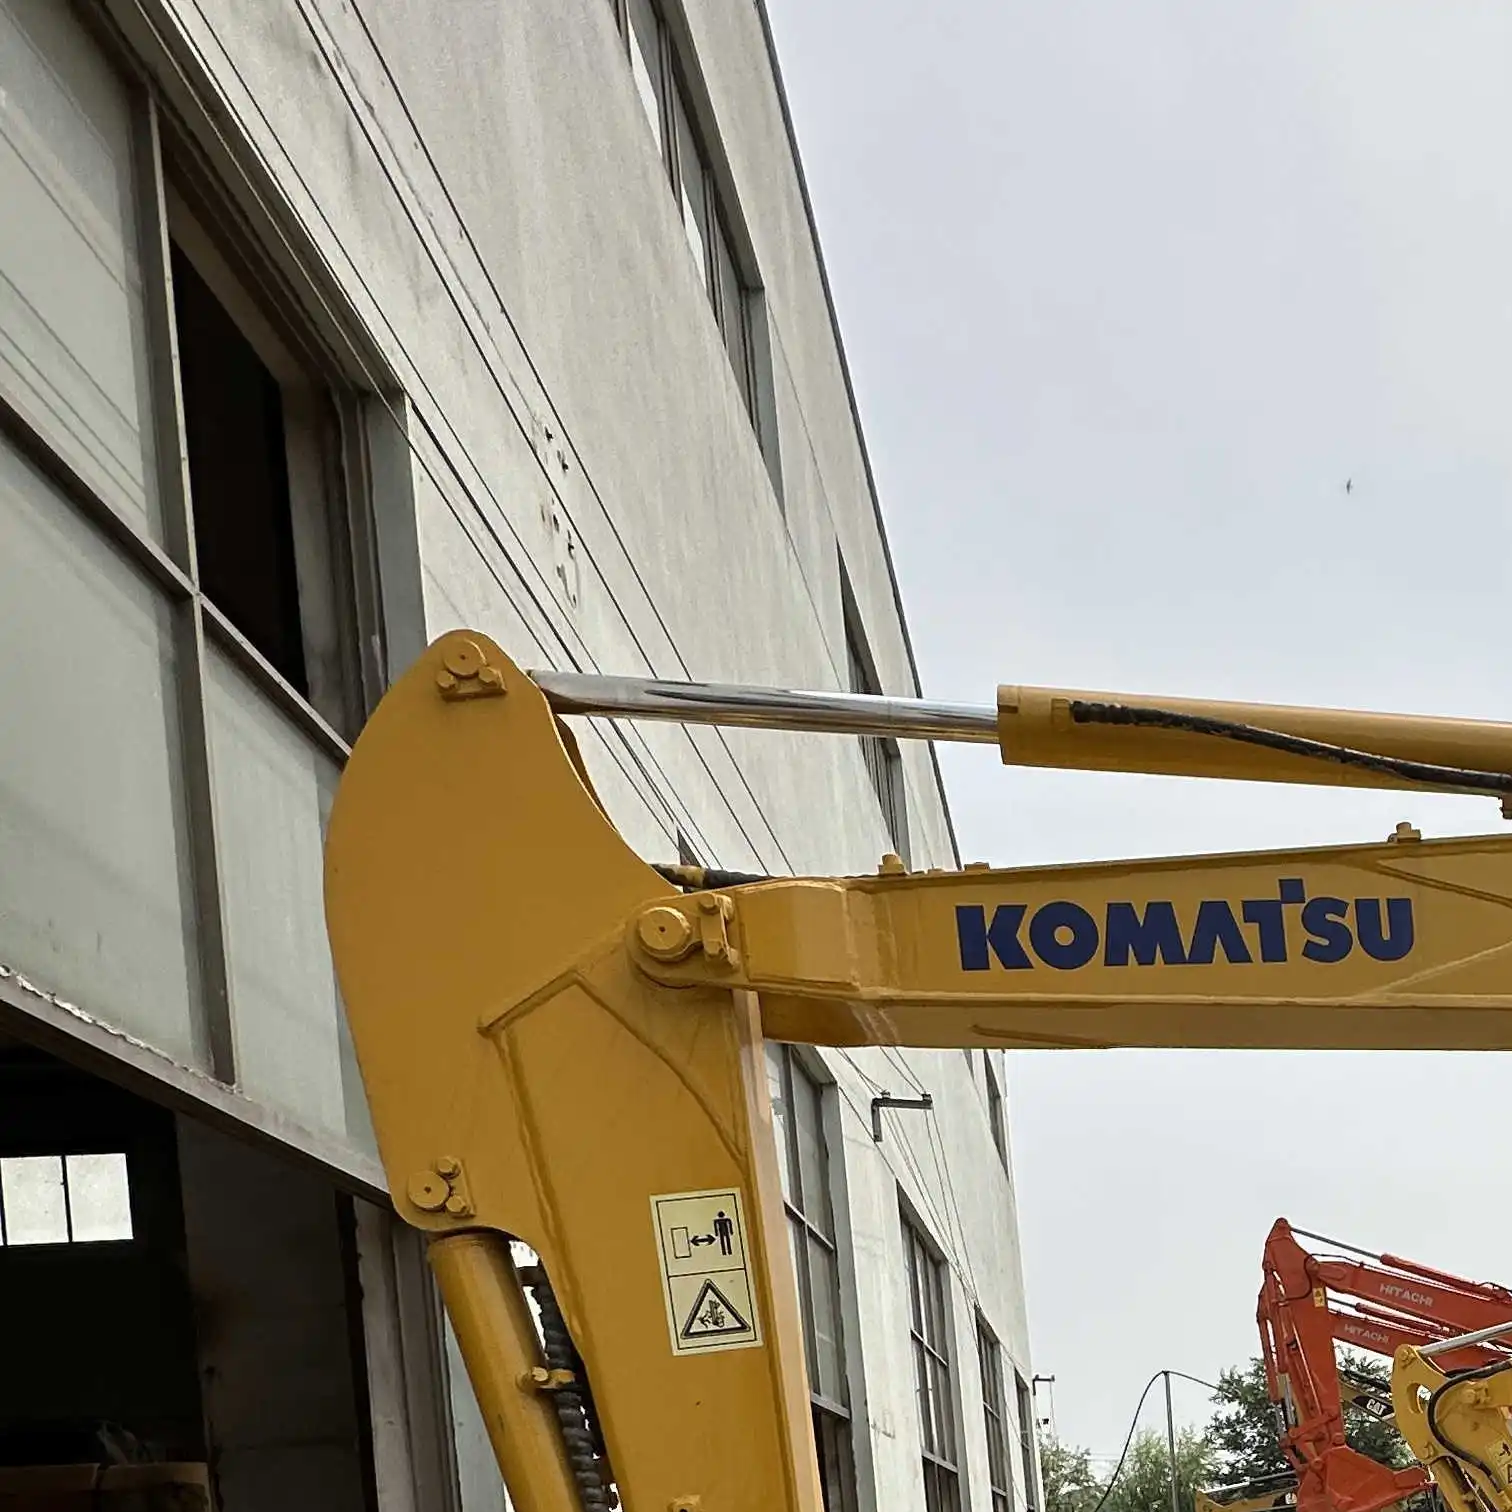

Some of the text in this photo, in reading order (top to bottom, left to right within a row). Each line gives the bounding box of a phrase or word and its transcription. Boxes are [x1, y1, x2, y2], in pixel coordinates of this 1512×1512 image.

[955, 878, 1414, 971] KOMATSU
[1379, 1283, 1434, 1307] HITACHI
[1344, 1323, 1390, 1344] HITACHI
